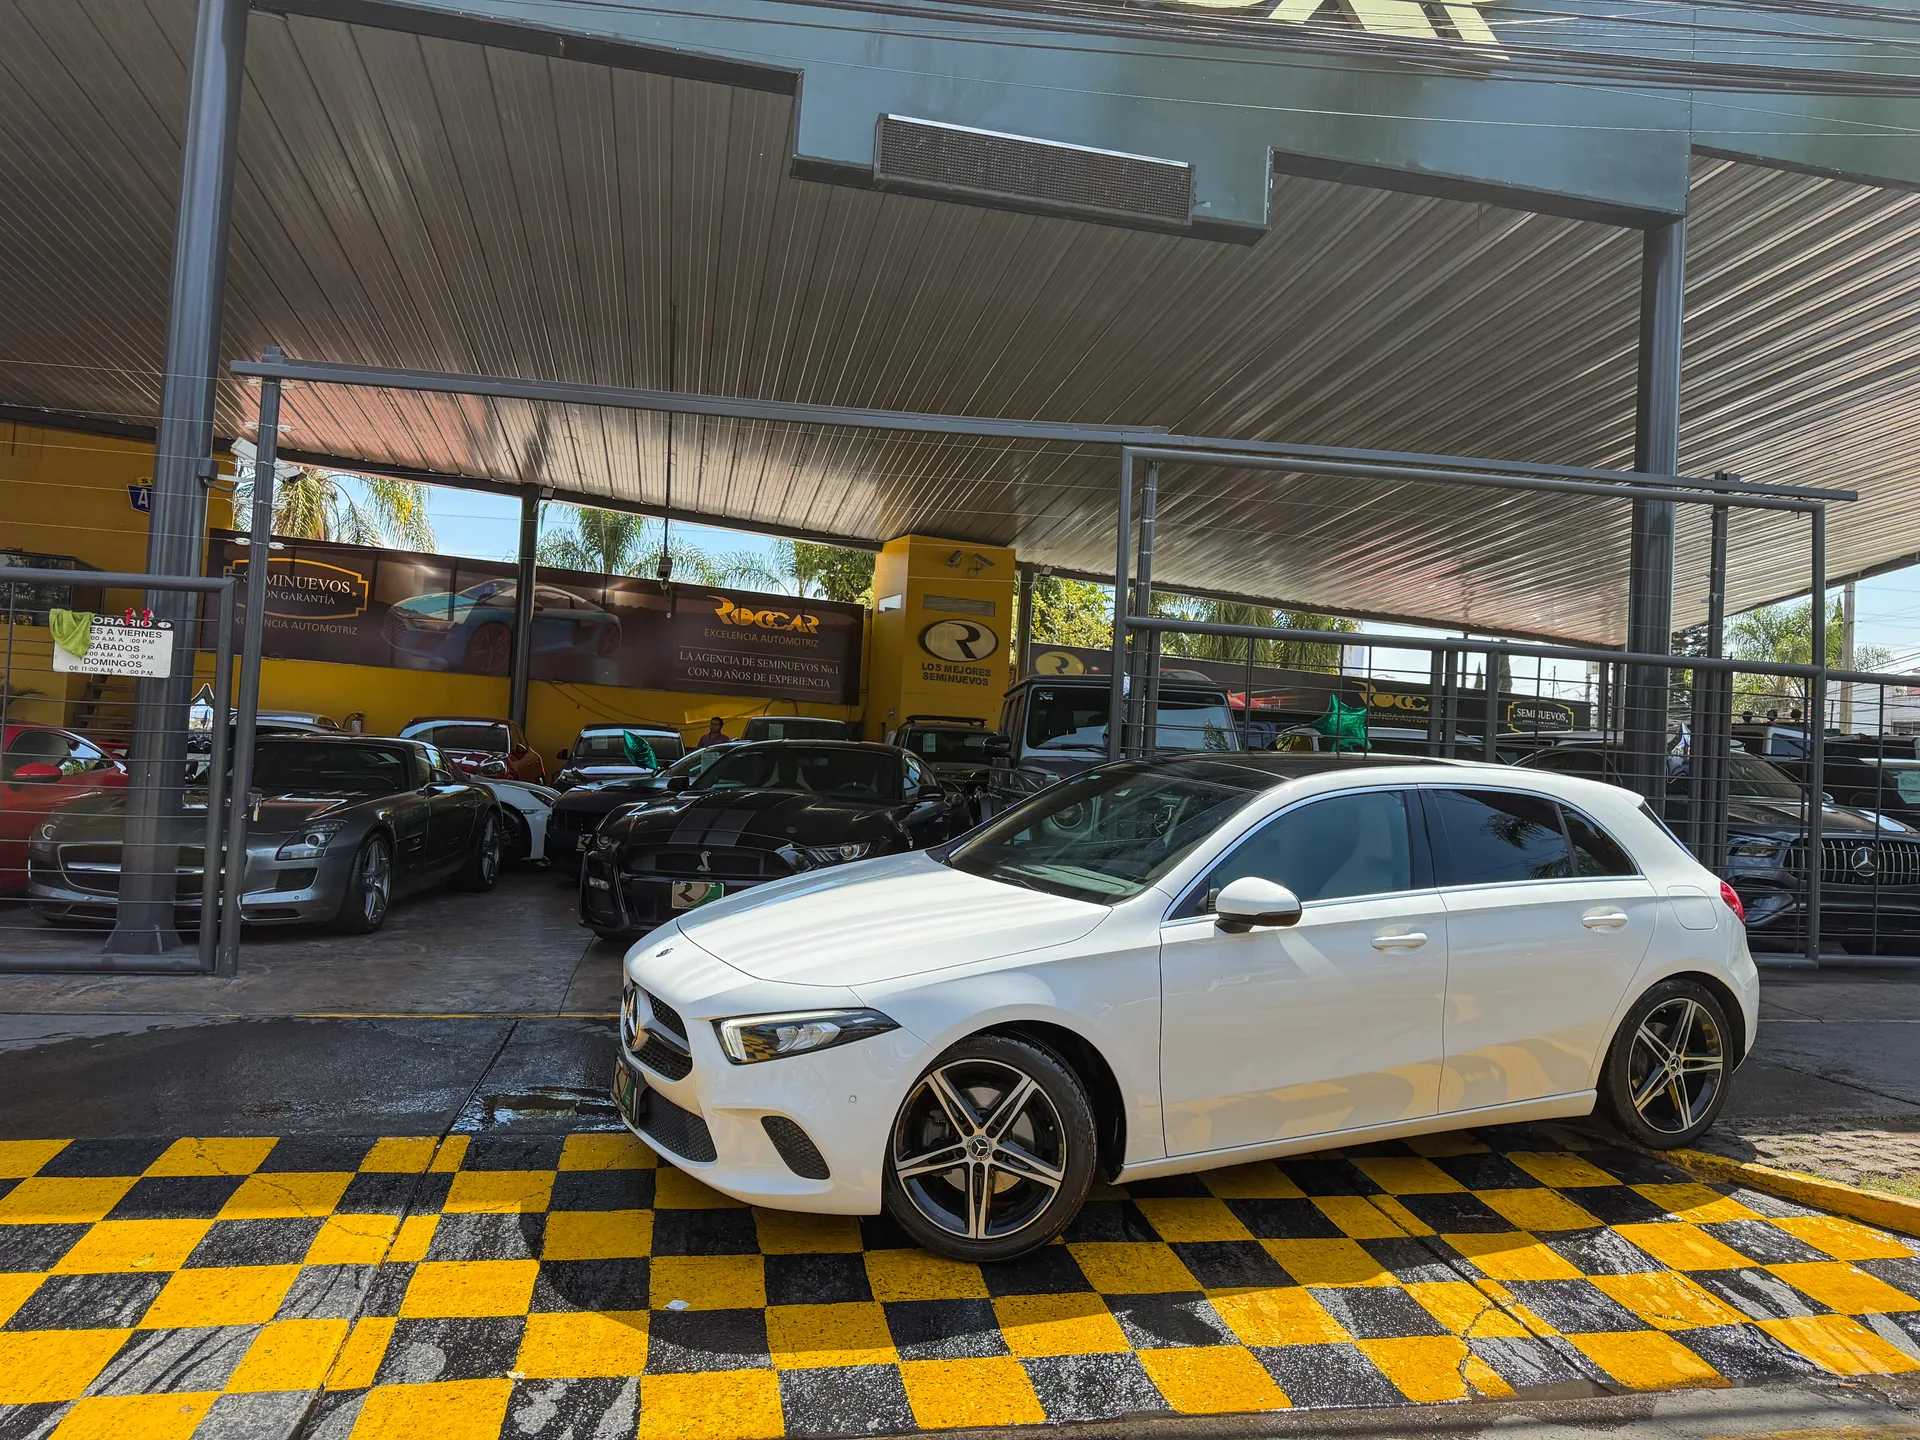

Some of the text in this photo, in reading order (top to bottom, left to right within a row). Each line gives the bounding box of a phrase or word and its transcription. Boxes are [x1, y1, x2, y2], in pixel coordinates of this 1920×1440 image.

[242, 570, 350, 594] SMINUEVOS
[281, 591, 335, 605] GARANTÍA
[706, 595, 820, 634] ROCCAR
[92, 616, 153, 628] ORARIO
[291, 621, 358, 636] AUTOMOTRIZ
[118, 629, 162, 639] VIERNES
[704, 628, 819, 648] EXCELENCIA AUTOMOTRIZ
[83, 658, 143, 668] DOMINGOS
[680, 651, 694, 661] LA
[694, 652, 740, 666] AGENCIA
[742, 657, 755, 667] DE
[757, 659, 819, 673] SEMINUEVOS
[921, 663, 992, 677] LOS MEJORES
[688, 667, 831, 688] CON 30 AÑOS DE EXPERIENCIA
[922, 672, 989, 686] SEMINUEVOS
